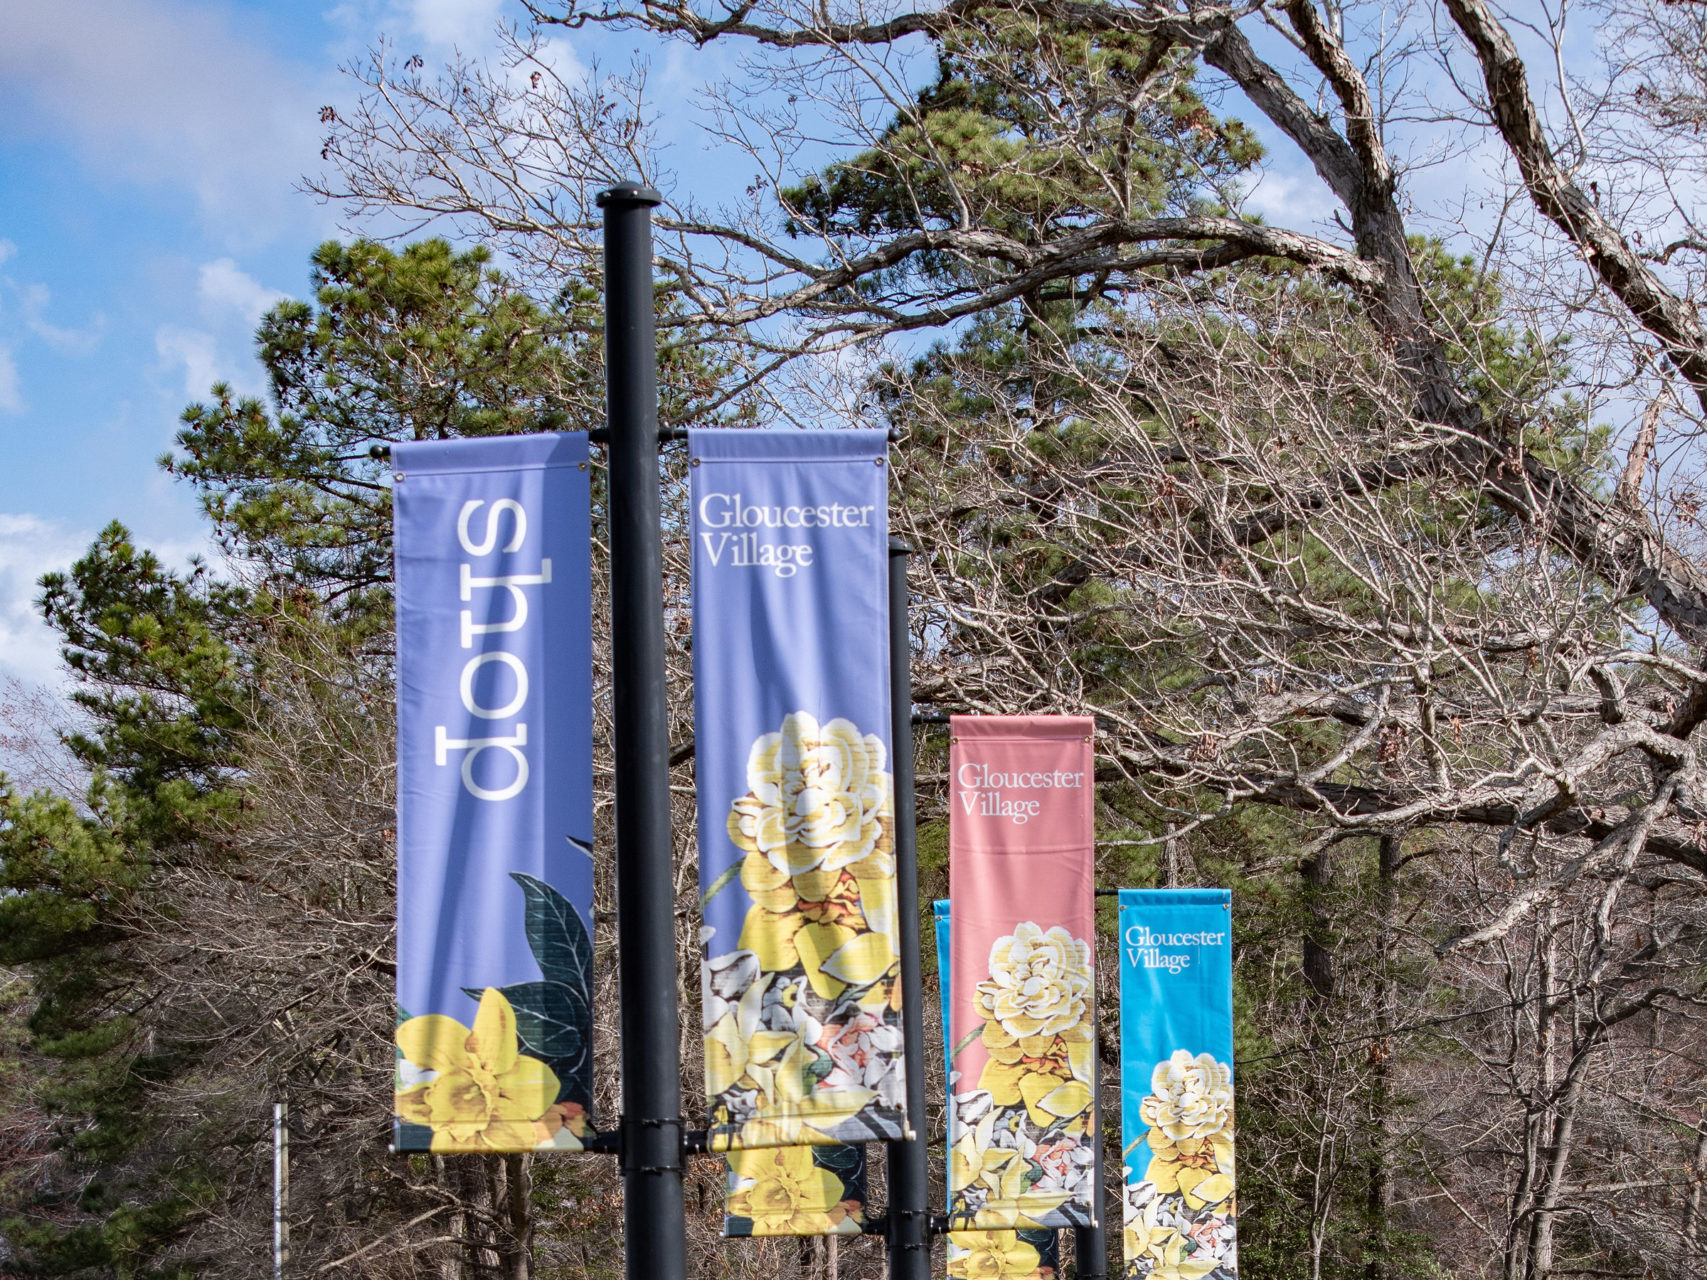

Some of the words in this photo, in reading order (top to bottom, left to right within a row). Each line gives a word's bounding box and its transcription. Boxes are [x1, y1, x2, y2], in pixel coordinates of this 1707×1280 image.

[699, 492, 874, 529] Gloucester
[700, 532, 813, 578] Village
[435, 498, 552, 802] shop
[957, 763, 1084, 789] Gloucester
[958, 791, 1041, 825] Village
[1125, 926, 1226, 947] Gloucester
[1126, 948, 1191, 974] Village
